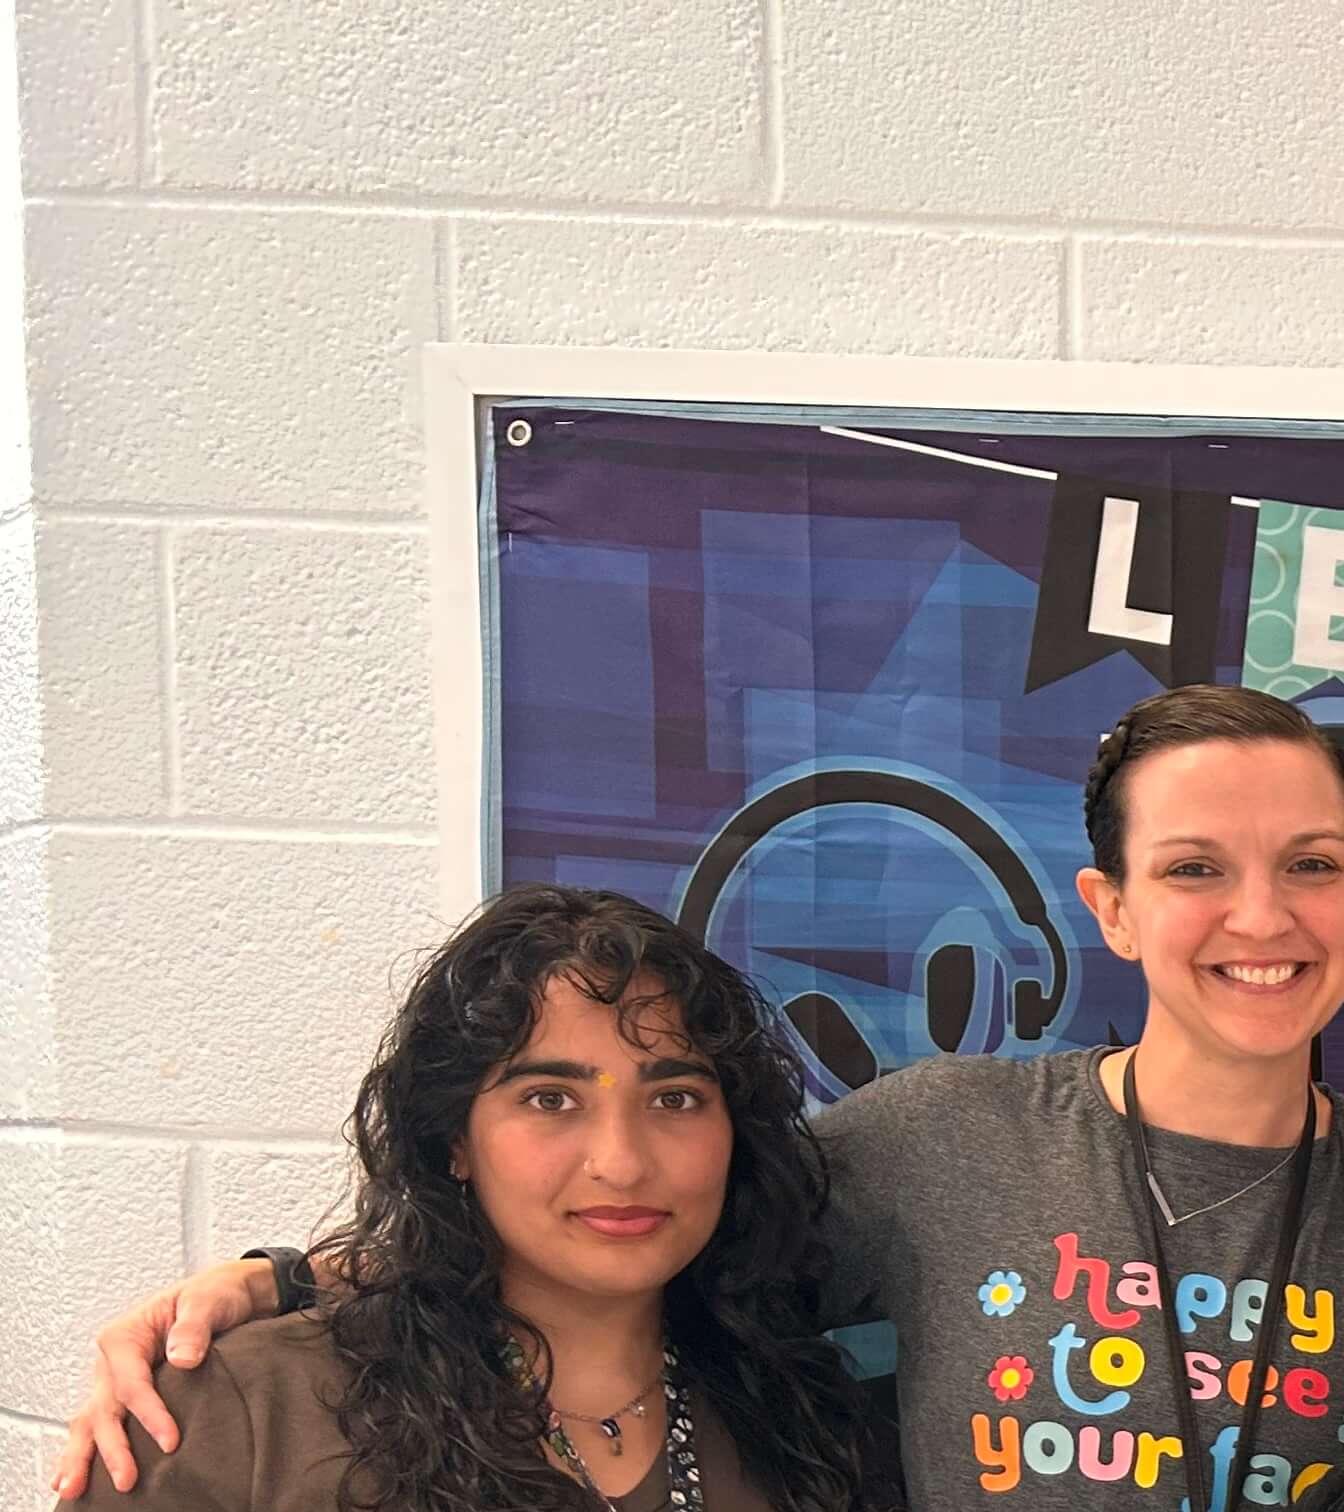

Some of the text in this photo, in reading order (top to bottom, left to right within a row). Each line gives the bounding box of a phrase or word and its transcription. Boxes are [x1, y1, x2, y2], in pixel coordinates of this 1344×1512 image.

[1053, 1232, 1335, 1354] happy
[1048, 1322, 1146, 1416] to
[1183, 1350, 1330, 1418] see
[971, 1413, 1184, 1492] your
